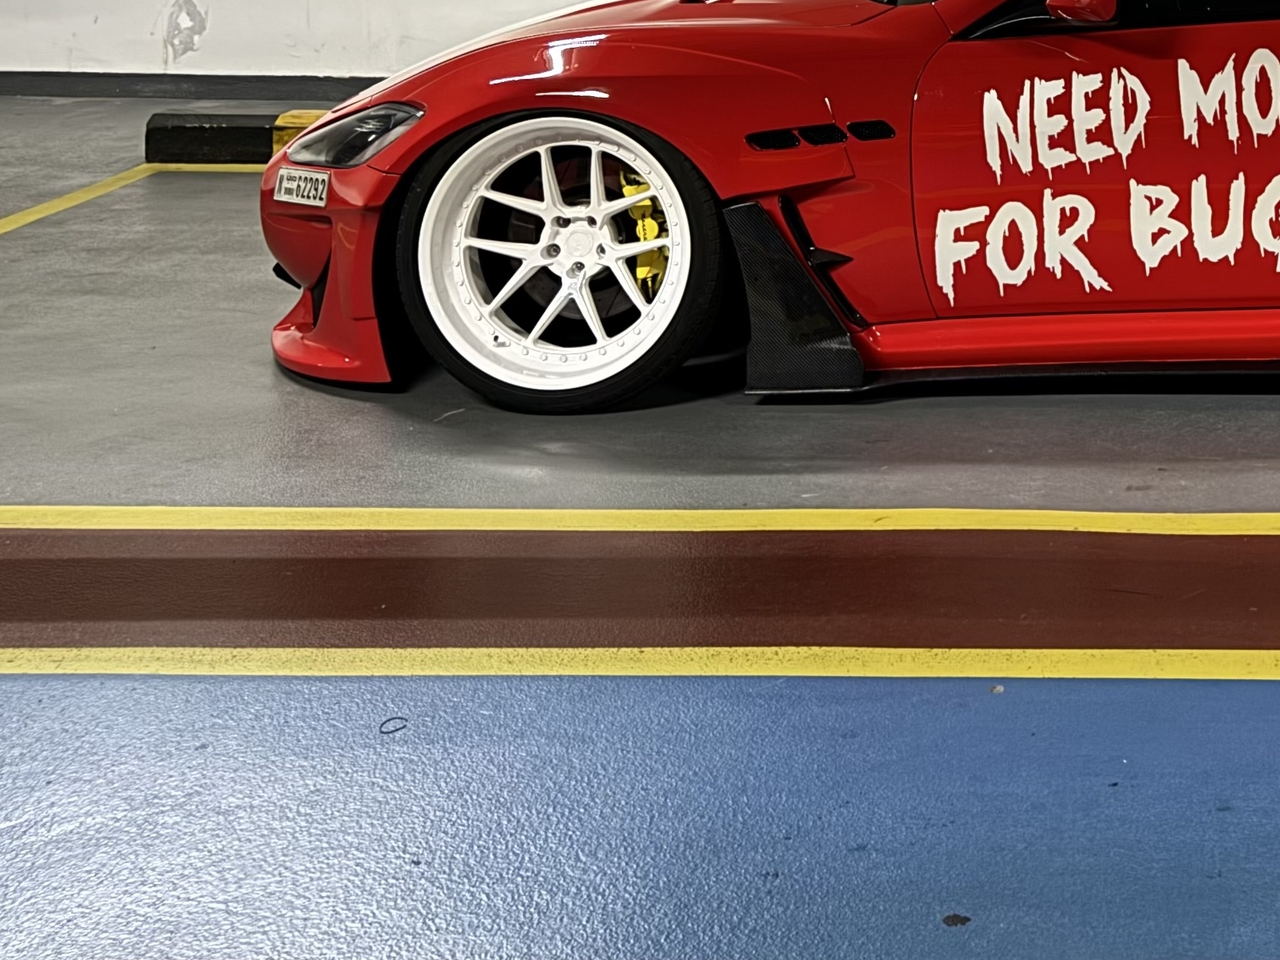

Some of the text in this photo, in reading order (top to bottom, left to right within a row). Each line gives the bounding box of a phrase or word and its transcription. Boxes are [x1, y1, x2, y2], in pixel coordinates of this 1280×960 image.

[983, 67, 1150, 184] NEED
[295, 175, 326, 201] 62292
[935, 188, 1112, 306] FOR
